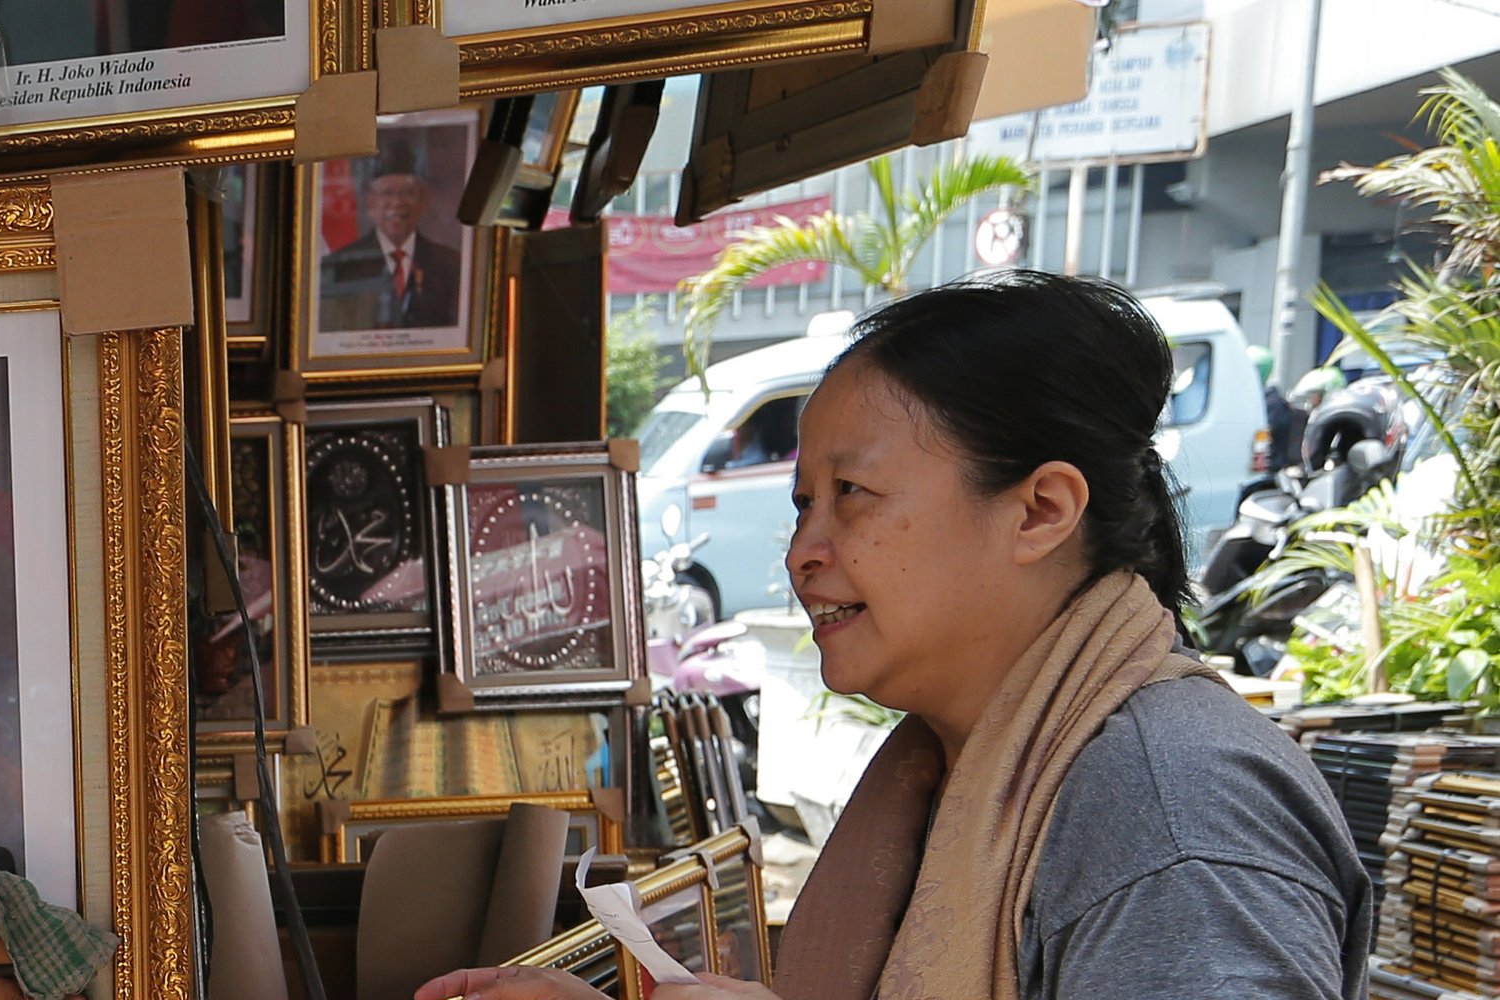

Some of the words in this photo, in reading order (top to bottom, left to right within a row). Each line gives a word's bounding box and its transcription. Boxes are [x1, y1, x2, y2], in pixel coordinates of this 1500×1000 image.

[15, 71, 32, 86] Ir.
[37, 67, 54, 83] H.
[58, 64, 95, 81] Joko
[99, 57, 155, 76] Widodo
[48, 82, 114, 104] Republik
[118, 73, 191, 94] Indonesia
